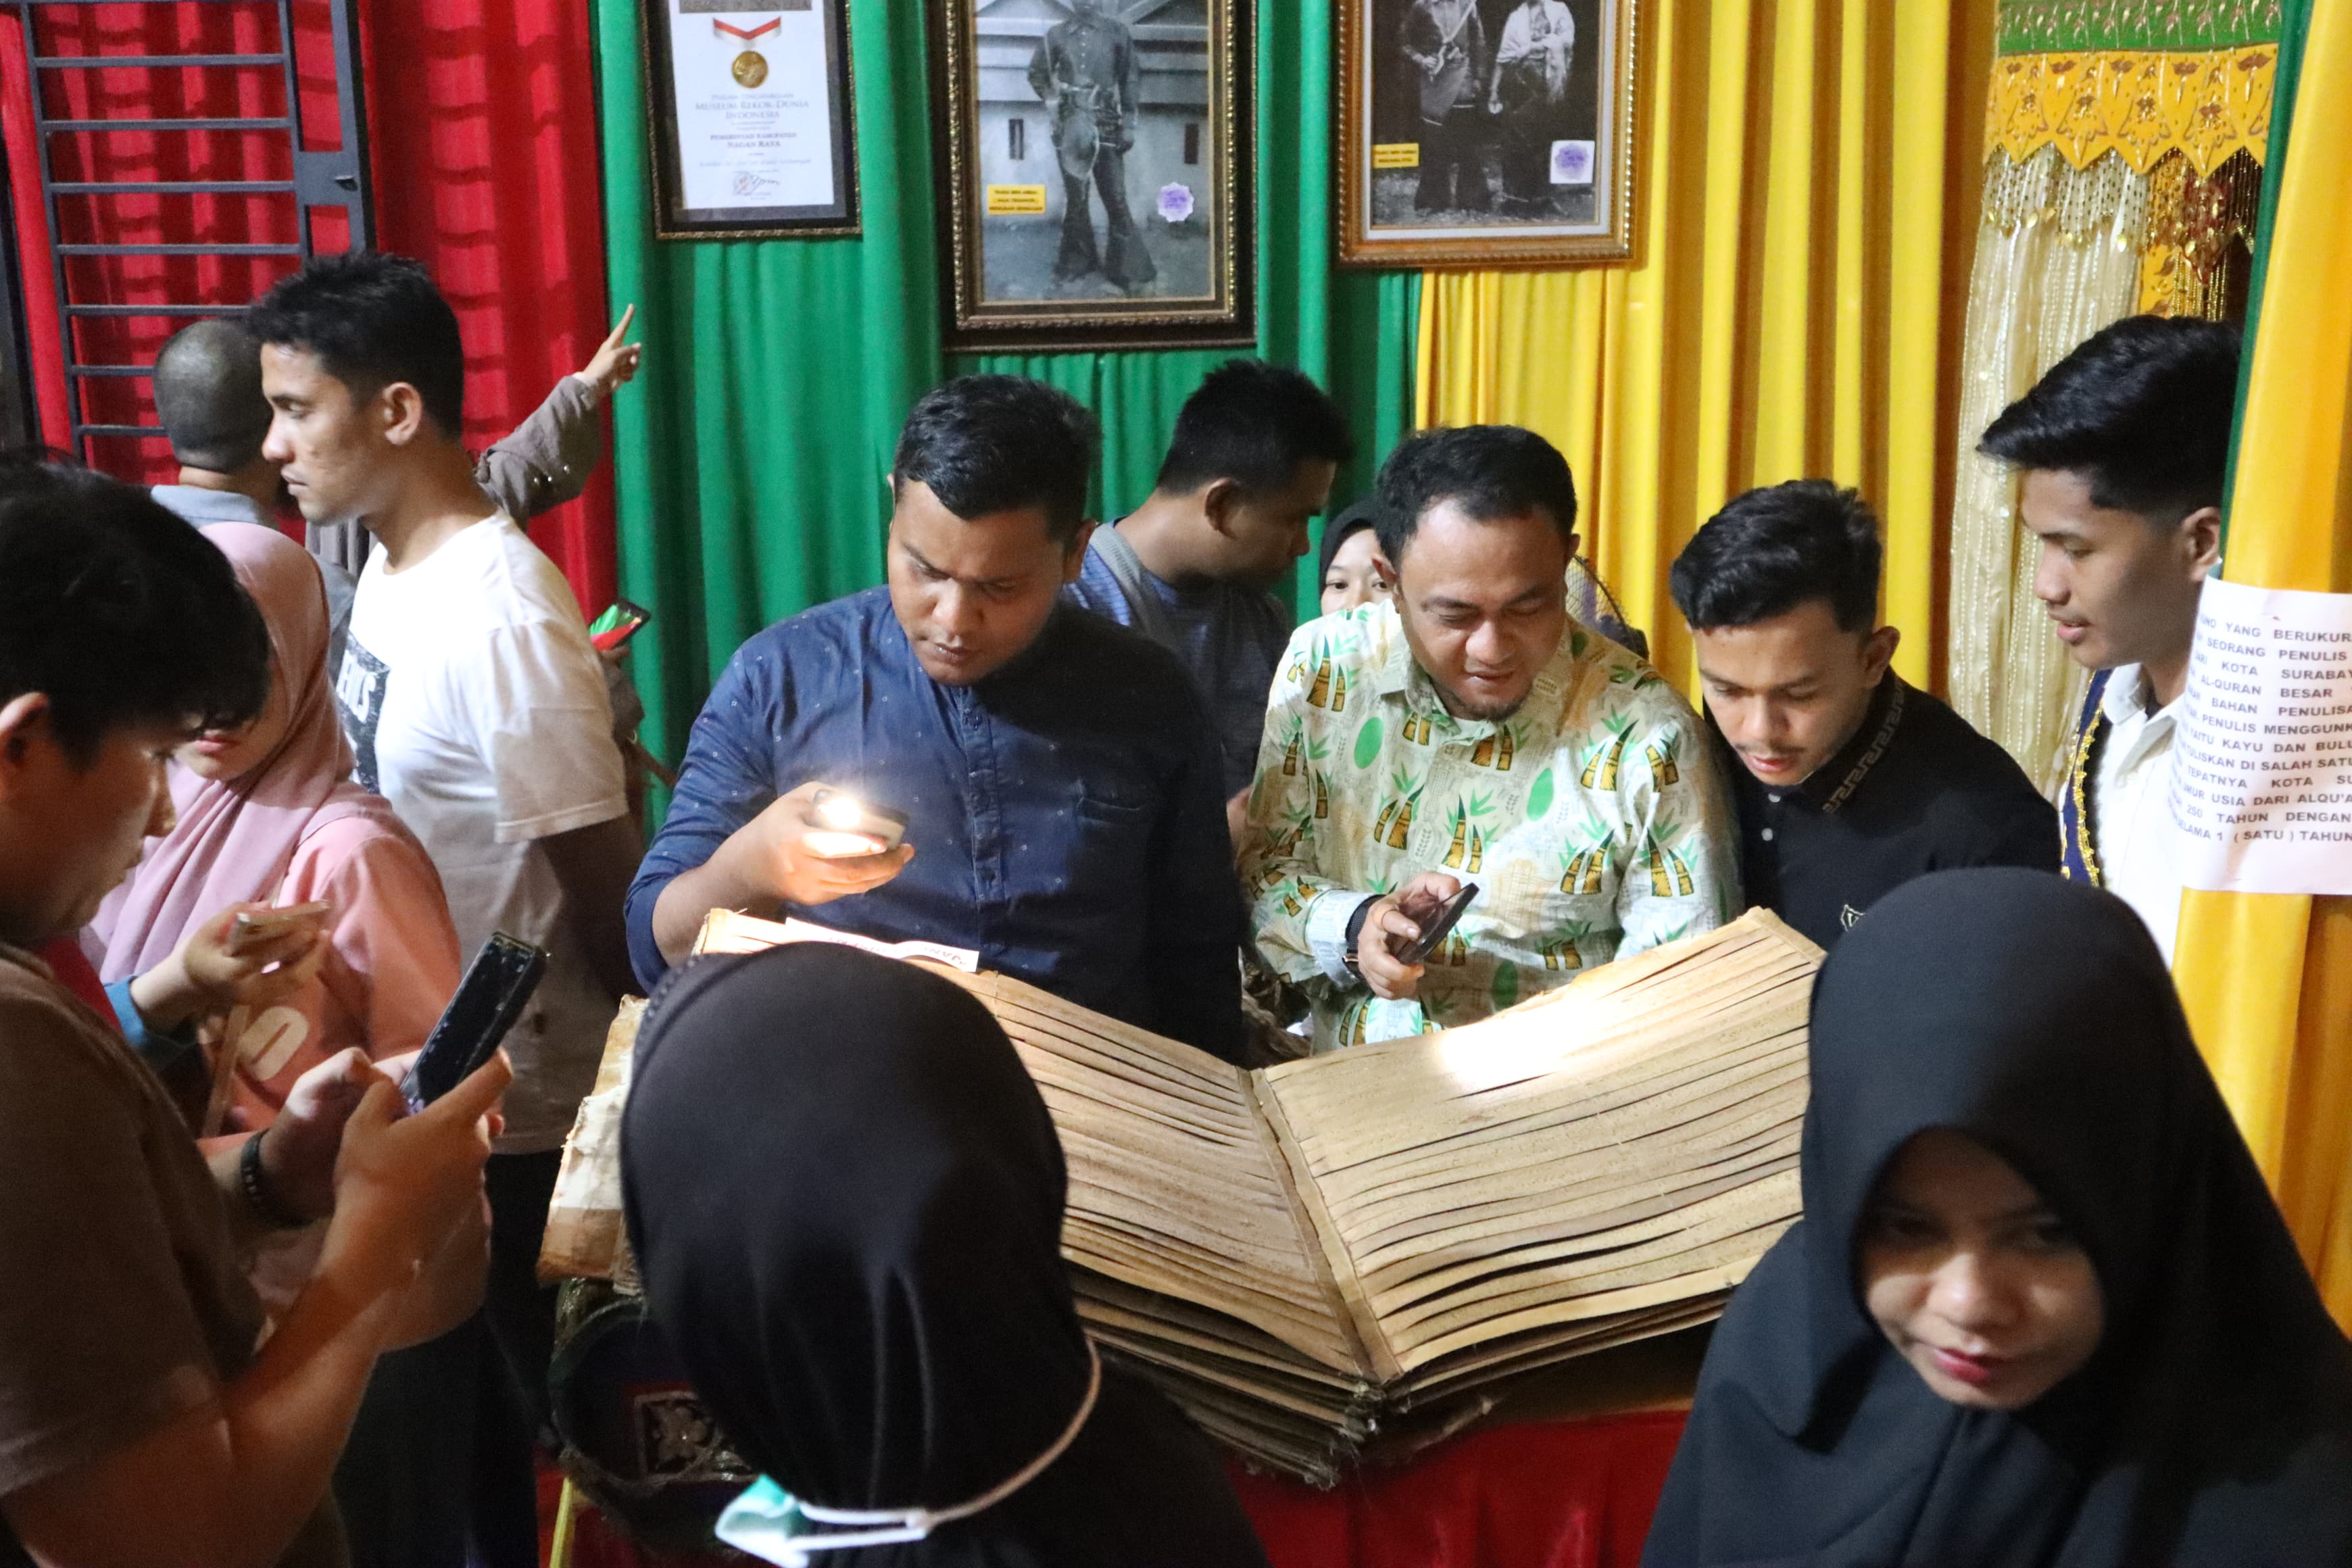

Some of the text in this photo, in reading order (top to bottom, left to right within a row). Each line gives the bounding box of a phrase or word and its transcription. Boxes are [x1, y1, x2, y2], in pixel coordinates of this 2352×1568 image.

[2226, 621, 2261, 638] YANG
[2207, 637, 2348, 662] SEORANG PENULIS
[2221, 661, 2259, 677] KOTA
[2201, 675, 2261, 695] AL-QURAN
[2280, 687, 2333, 699] BESAR
[2211, 697, 2258, 714] BAHAN
[2202, 713, 2257, 733] PENULIS
[2222, 738, 2263, 752] KAYU
[2274, 743, 2305, 753] DAN
[2240, 760, 2255, 771] DI
[2261, 760, 2312, 771] SALAH
[2187, 764, 2248, 789] TEPATNYA
[2271, 777, 2313, 788] KOTA
[2211, 793, 2246, 806] USIA
[2253, 795, 2289, 806] DARI
[2186, 804, 2203, 818] 250
[2216, 812, 2269, 824] TAHUN
[2286, 812, 2352, 823] DENGAN
[2216, 832, 2223, 841] 1
[2243, 829, 2284, 840] SATU
